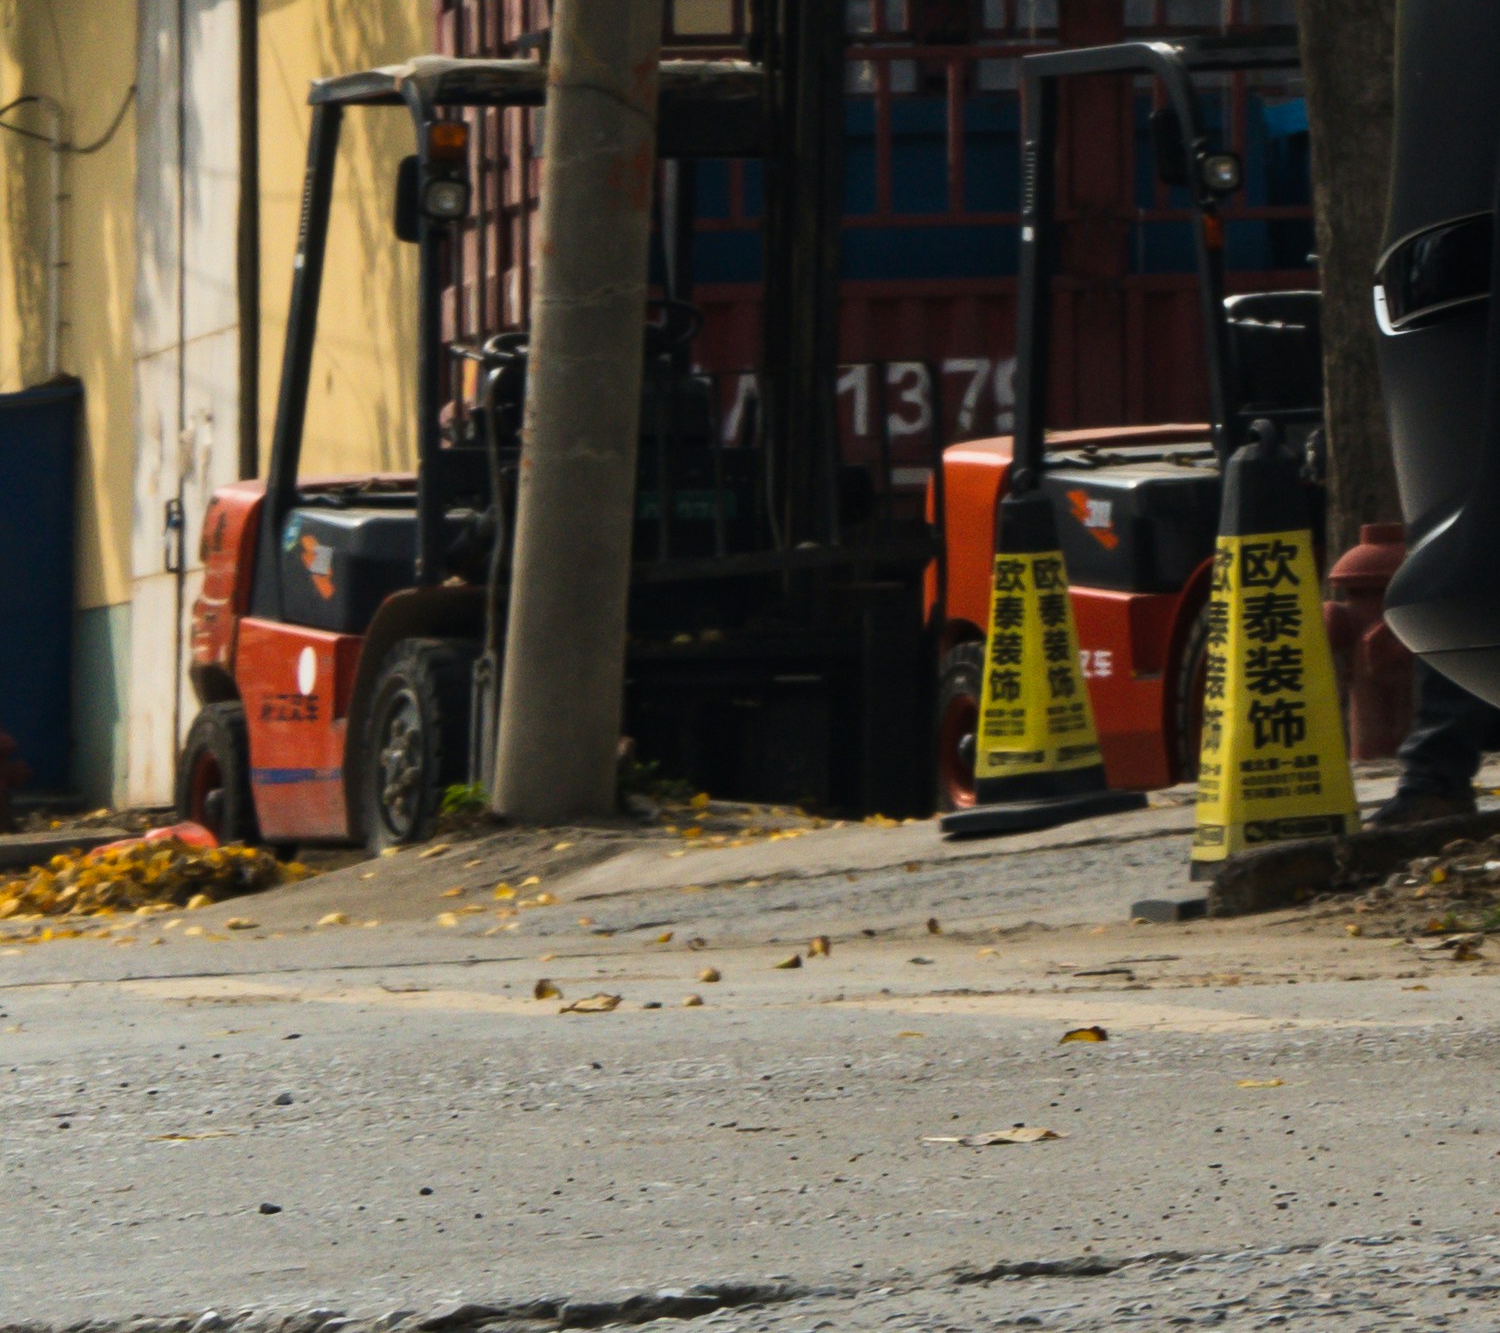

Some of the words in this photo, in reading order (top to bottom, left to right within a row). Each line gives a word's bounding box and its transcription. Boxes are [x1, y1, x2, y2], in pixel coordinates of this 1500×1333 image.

[991, 558, 1027, 702] 欧泰装饰
[1032, 557, 1078, 700] 欧泰装饰
[1240, 539, 1306, 749] 欧泰装饰
